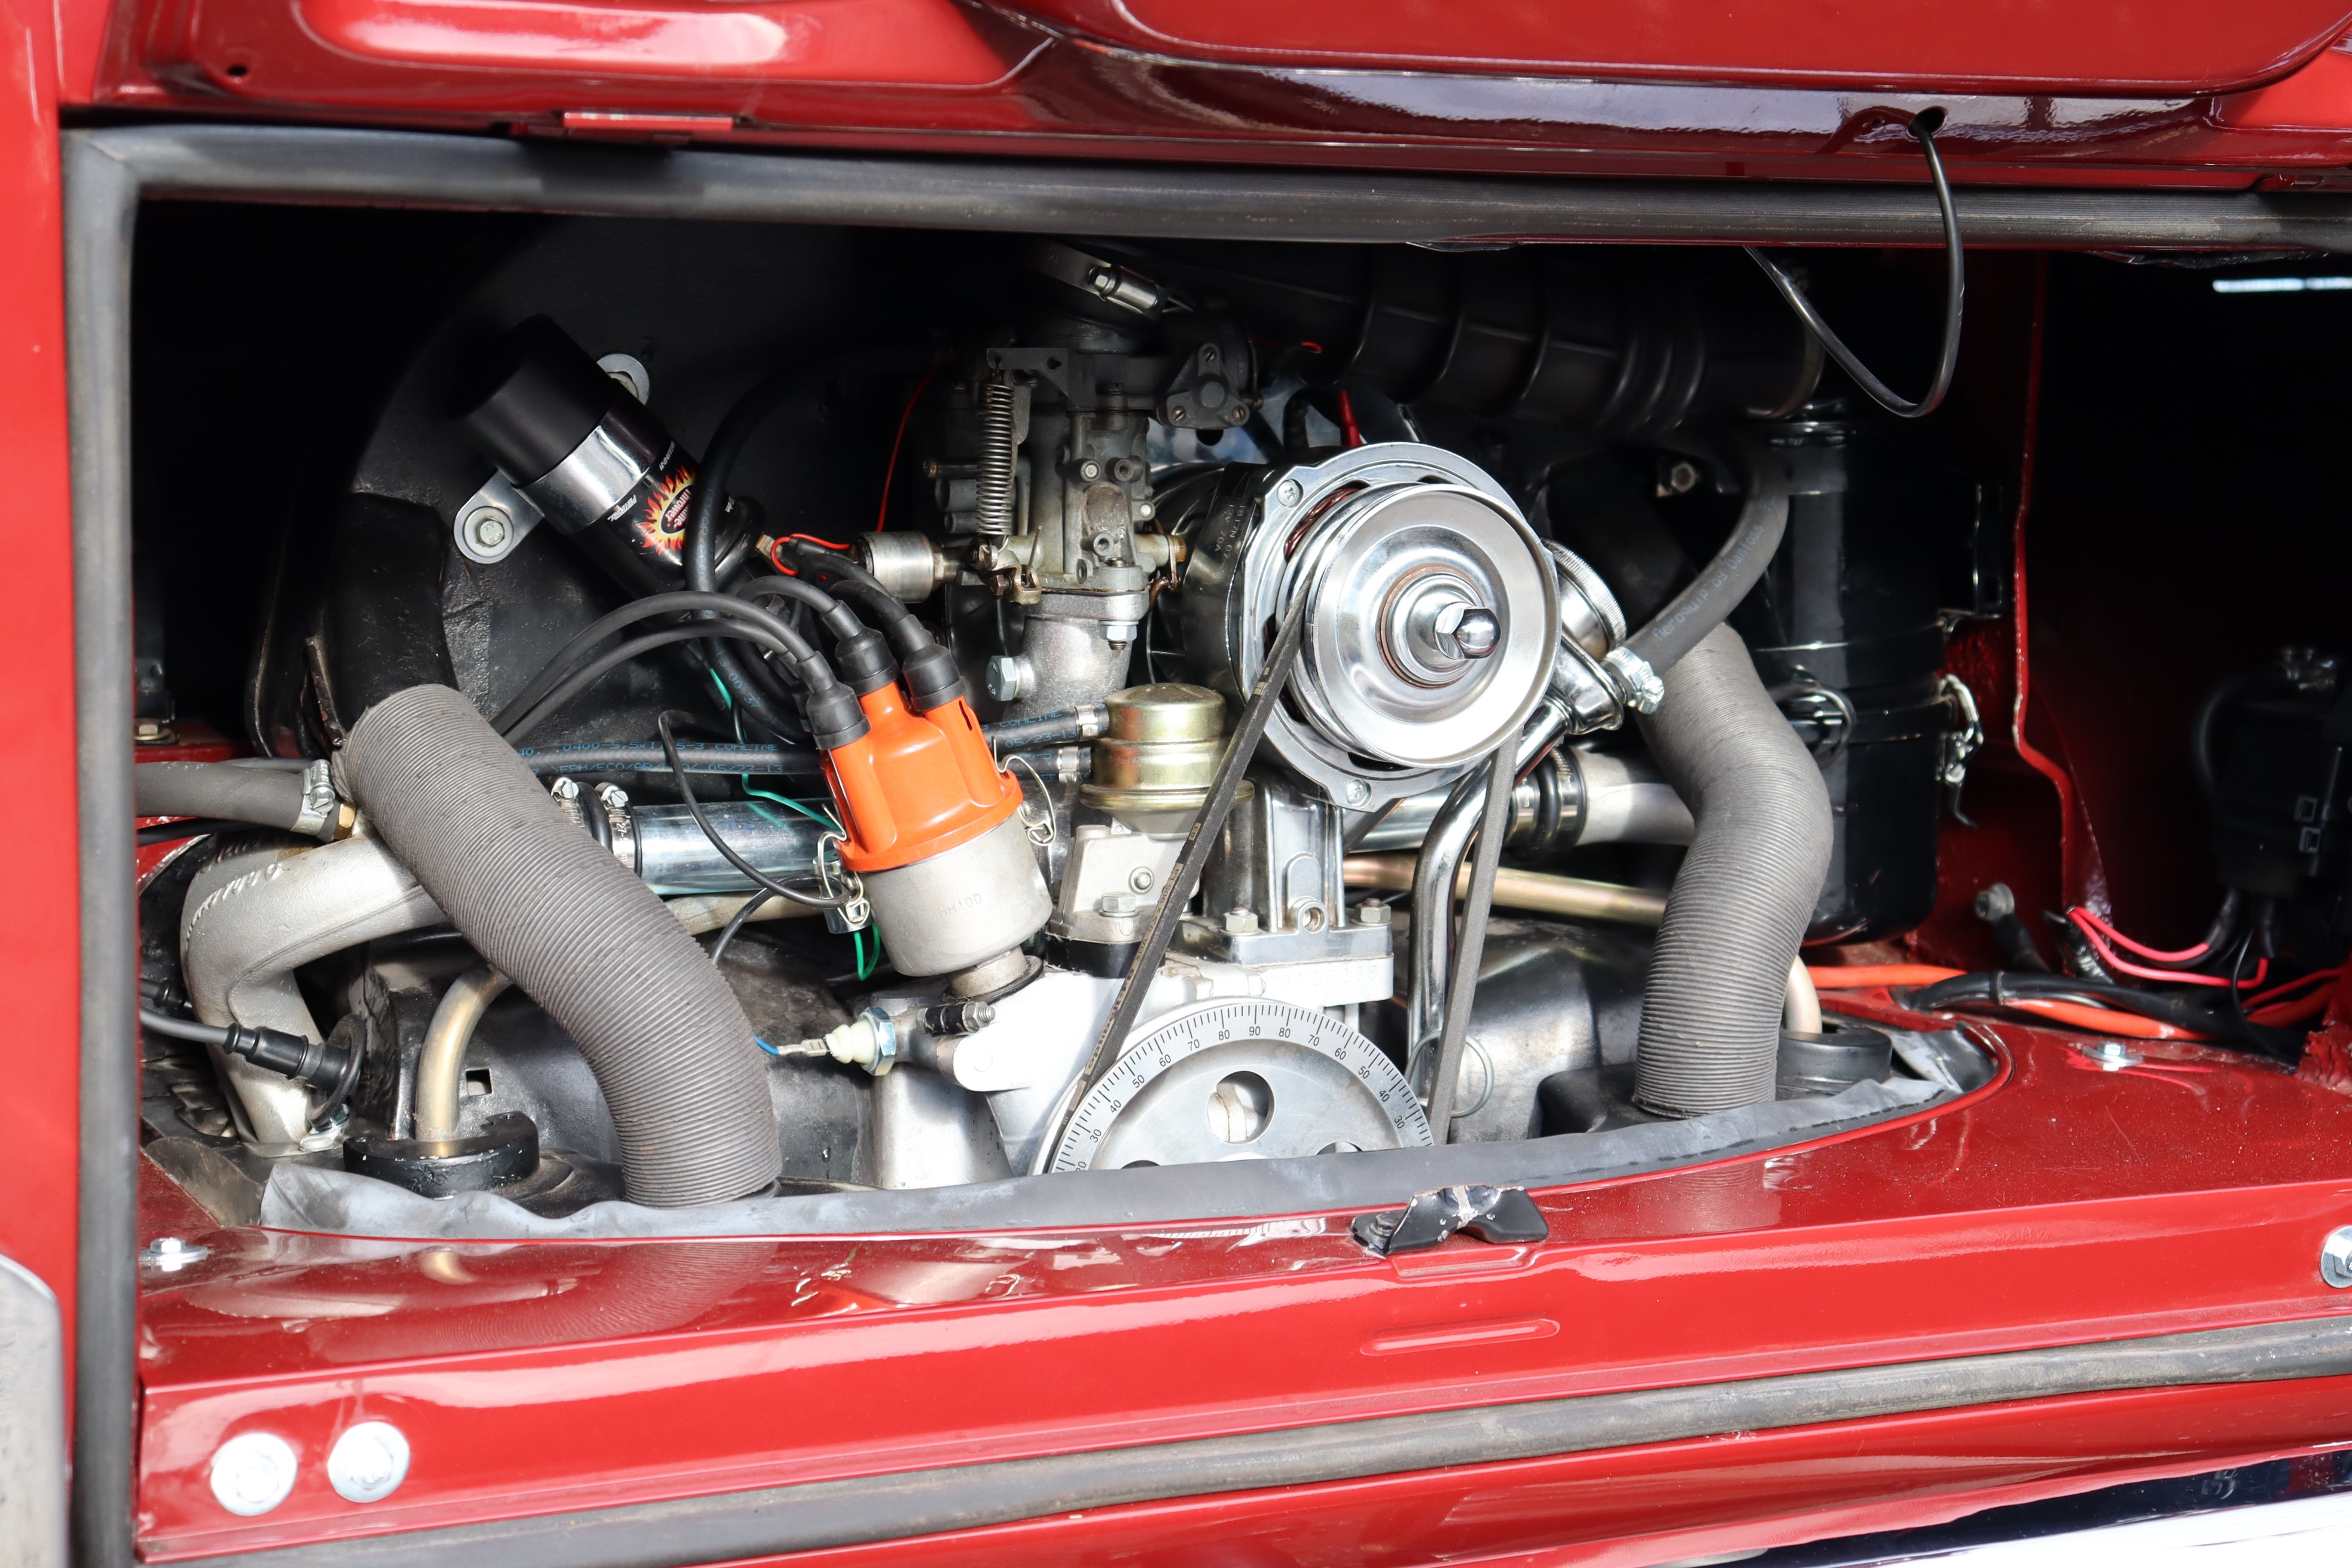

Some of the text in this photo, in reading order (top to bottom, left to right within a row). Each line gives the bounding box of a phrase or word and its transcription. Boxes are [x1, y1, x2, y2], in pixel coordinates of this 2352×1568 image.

[1215, 530, 1226, 551] 70A
[1653, 524, 1764, 640] Aeroquip by Danfoss
[1005, 727, 1077, 748] 05/23-13
[1160, 883, 1172, 903] 905
[1170, 868, 1180, 881] La
[1090, 1129, 1102, 1143] 30
[1109, 1099, 1122, 1114] 40
[1132, 1074, 1146, 1088] 50
[1158, 1054, 1172, 1067] 60
[1187, 1039, 1200, 1051] 70
[1218, 1029, 1230, 1041] 80
[1249, 1026, 1261, 1036] 90
[1279, 1027, 1291, 1039] 80
[1308, 1034, 1320, 1047] 70
[1334, 1047, 1347, 1060] 60
[1358, 1066, 1370, 1079] 50
[1379, 1090, 1390, 1103] 40
[1394, 1115, 1405, 1129] 30
